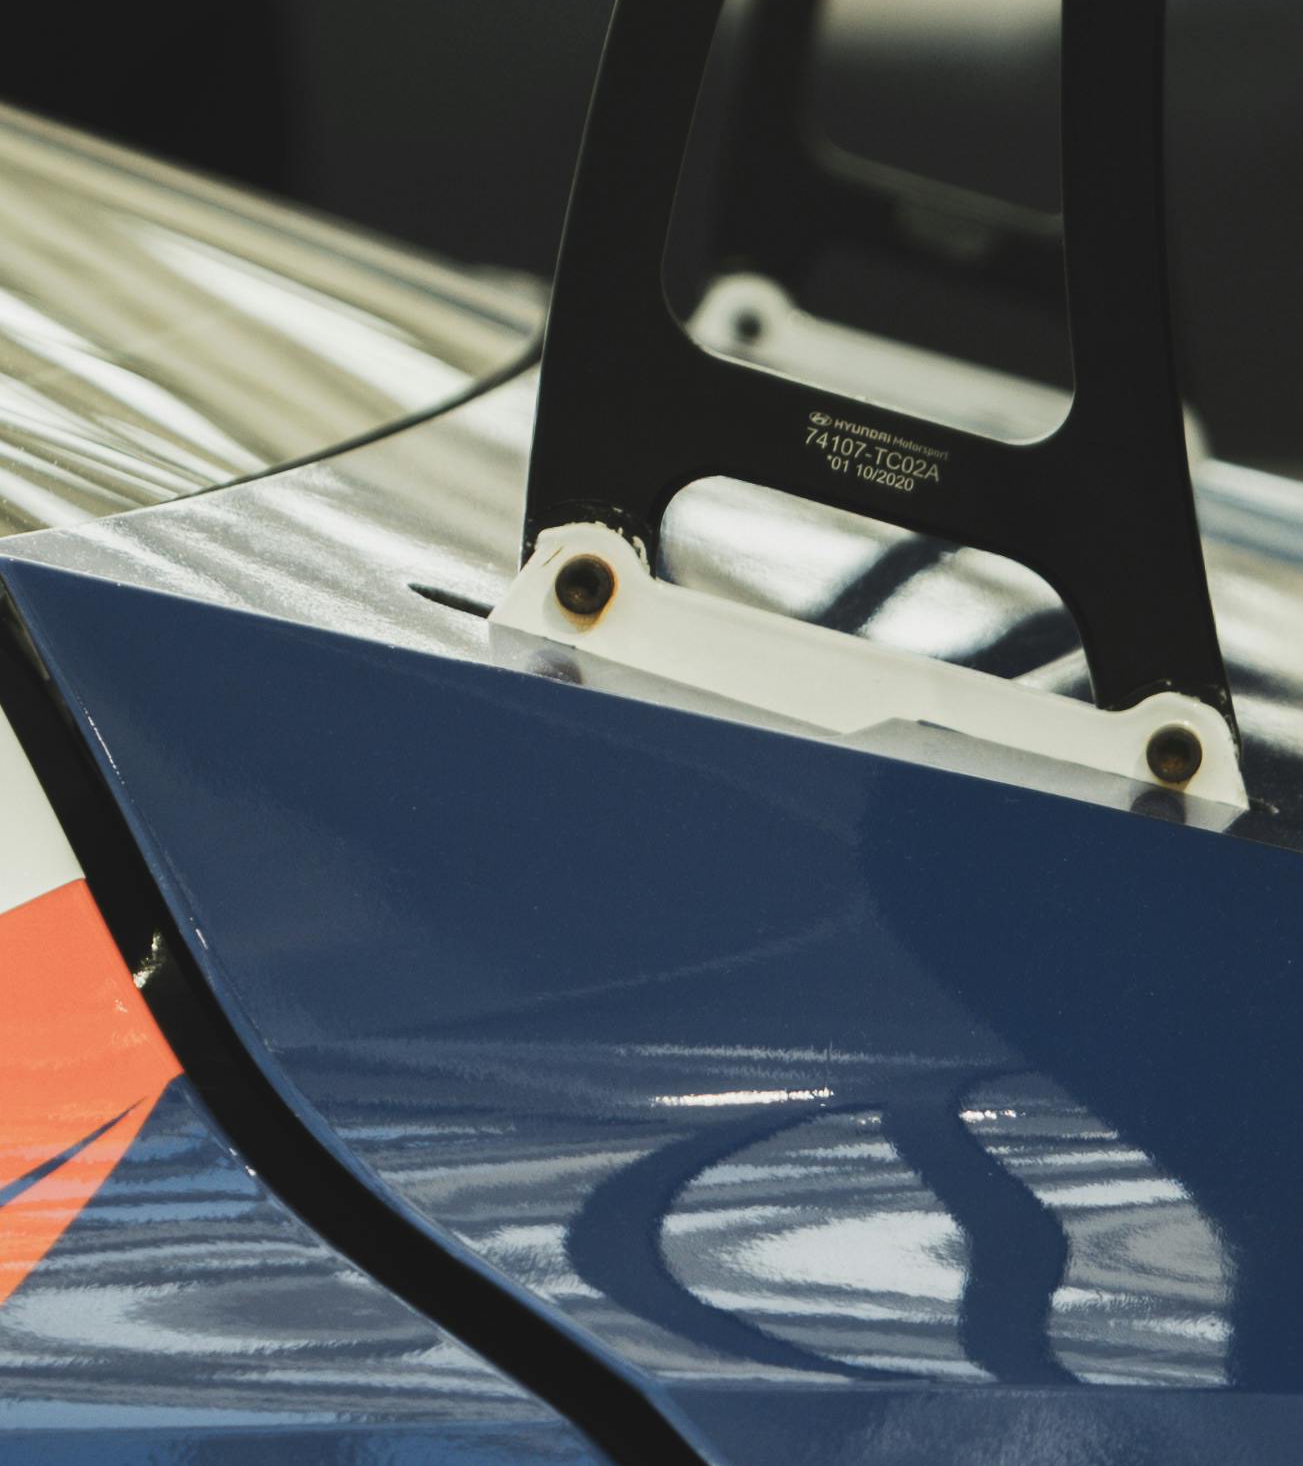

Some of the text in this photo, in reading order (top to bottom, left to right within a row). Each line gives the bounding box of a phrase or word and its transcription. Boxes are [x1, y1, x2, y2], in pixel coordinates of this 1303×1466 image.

[805, 426, 940, 483] 74107-TC02A
[834, 418, 949, 461] HYUNDAI Motorsport
[856, 463, 915, 492] 10/2020
